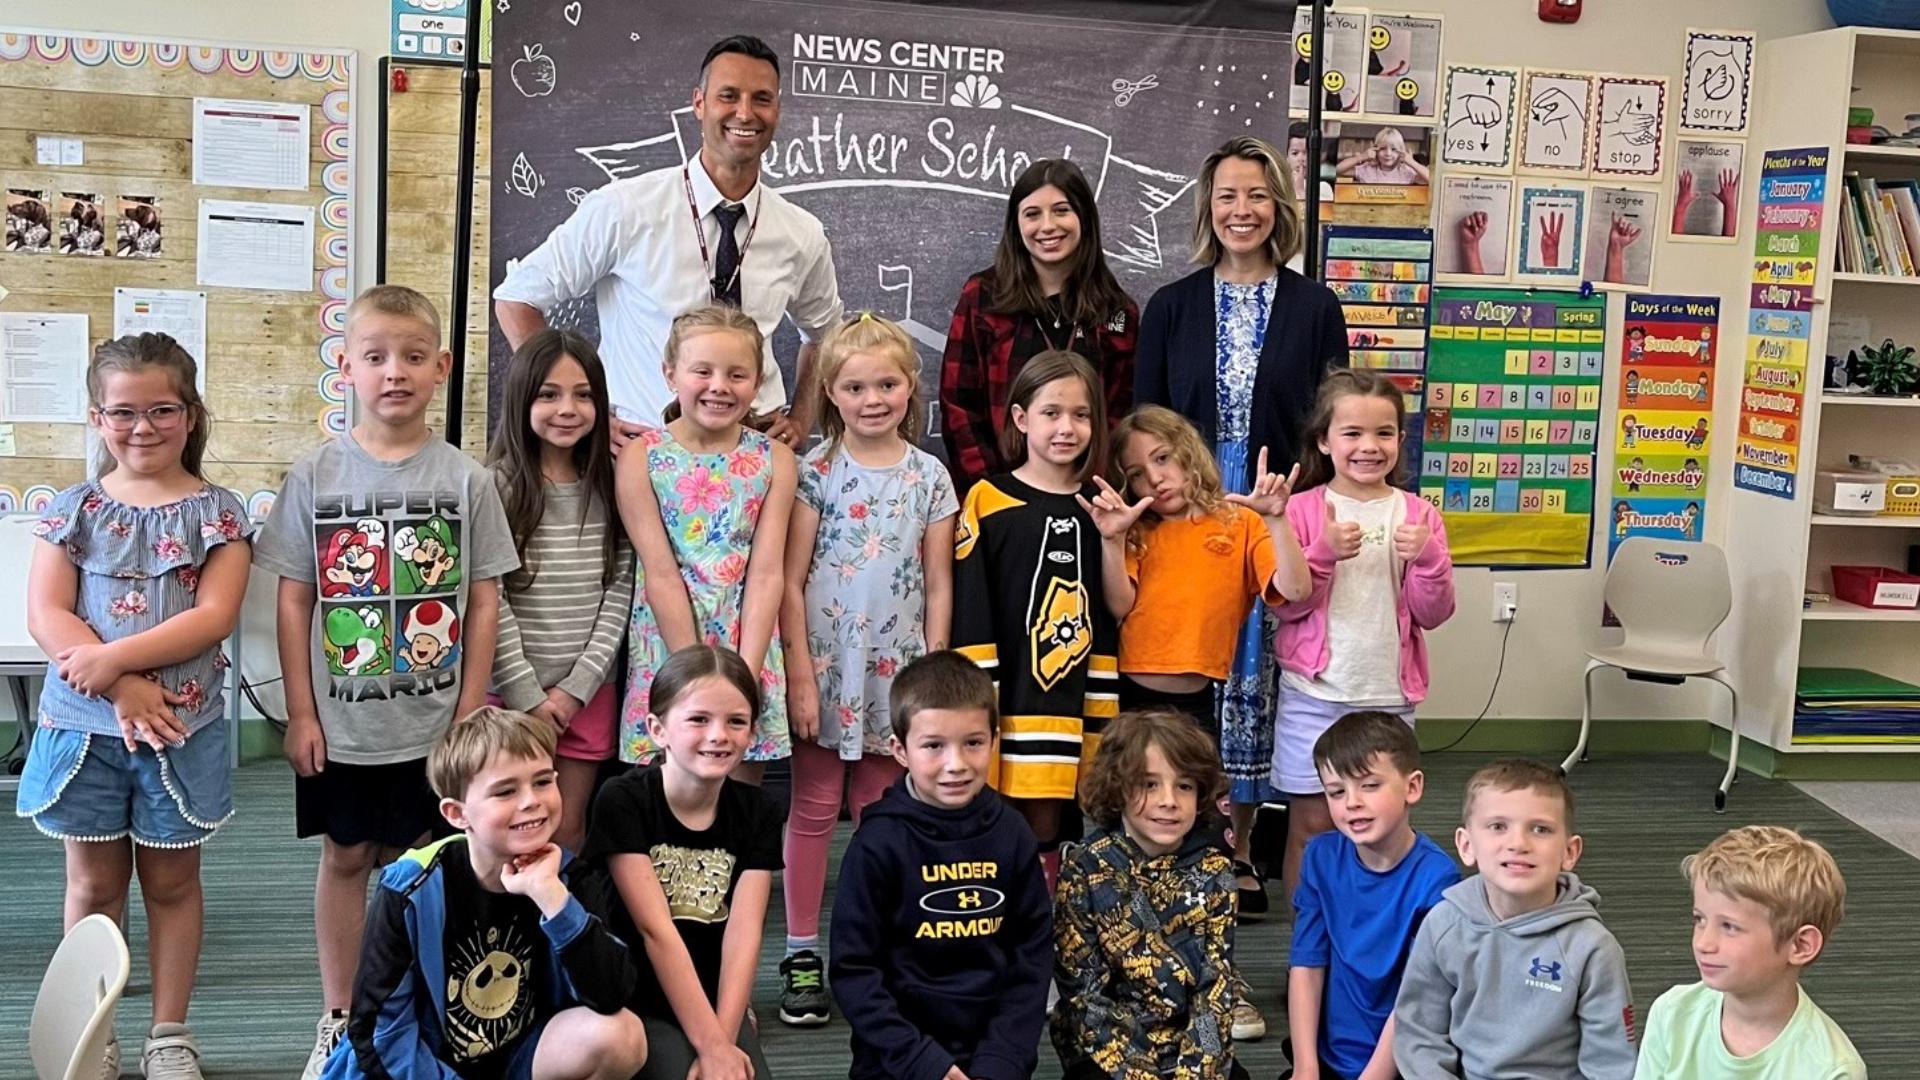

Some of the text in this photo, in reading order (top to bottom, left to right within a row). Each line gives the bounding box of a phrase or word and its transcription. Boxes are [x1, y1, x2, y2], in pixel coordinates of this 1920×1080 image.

[421, 20, 444, 29] one
[1301, 15, 1358, 30] Thk You
[793, 33, 1005, 73] NEWS CENTER
[801, 66, 939, 101] MAINE
[1693, 108, 1732, 123] sorry
[760, 112, 1072, 188] eather Scho
[1448, 137, 1474, 151] yes
[1544, 145, 1561, 156] no
[1688, 146, 1731, 157] applause
[1610, 151, 1642, 166] stop
[1764, 157, 1791, 170] Months
[1807, 155, 1826, 169] Year
[1605, 192, 1644, 209] I agree
[1769, 180, 1812, 201] January
[1764, 206, 1810, 228] February
[1768, 235, 1800, 253] March
[1770, 261, 1793, 281] April
[1767, 285, 1792, 309] May
[1474, 301, 1595, 326] May Spring
[1631, 301, 1716, 316] Days of the Week
[1644, 335, 1701, 357] Sunday
[1765, 341, 1784, 363] July
[1538, 356, 1546, 368] 2
[1563, 357, 1571, 368] 3
[1587, 357, 1595, 368] 4
[1755, 365, 1790, 387] August
[1436, 388, 1592, 403] 5 6 7 8 9 10 11
[1638, 378, 1701, 400] Monday
[1745, 388, 1796, 412] September
[1456, 425, 1591, 440] 13 14 15 16 17 18
[1634, 423, 1696, 443] Tuesday
[1750, 417, 1786, 439] October
[1742, 444, 1789, 466] November
[1428, 460, 1589, 475] 19 20 21 22 23 24 25
[1618, 469, 1704, 489] Wednesday
[1740, 466, 1787, 492] December
[315, 490, 461, 519] SUPER
[1473, 496, 1490, 507] 28
[1523, 496, 1539, 508] 30
[1547, 495, 1560, 507] 31
[1622, 511, 1693, 532] Thursday
[328, 669, 457, 703] MARIO
[921, 861, 998, 883] UNDER
[1525, 978, 1563, 993] FREEDOM
